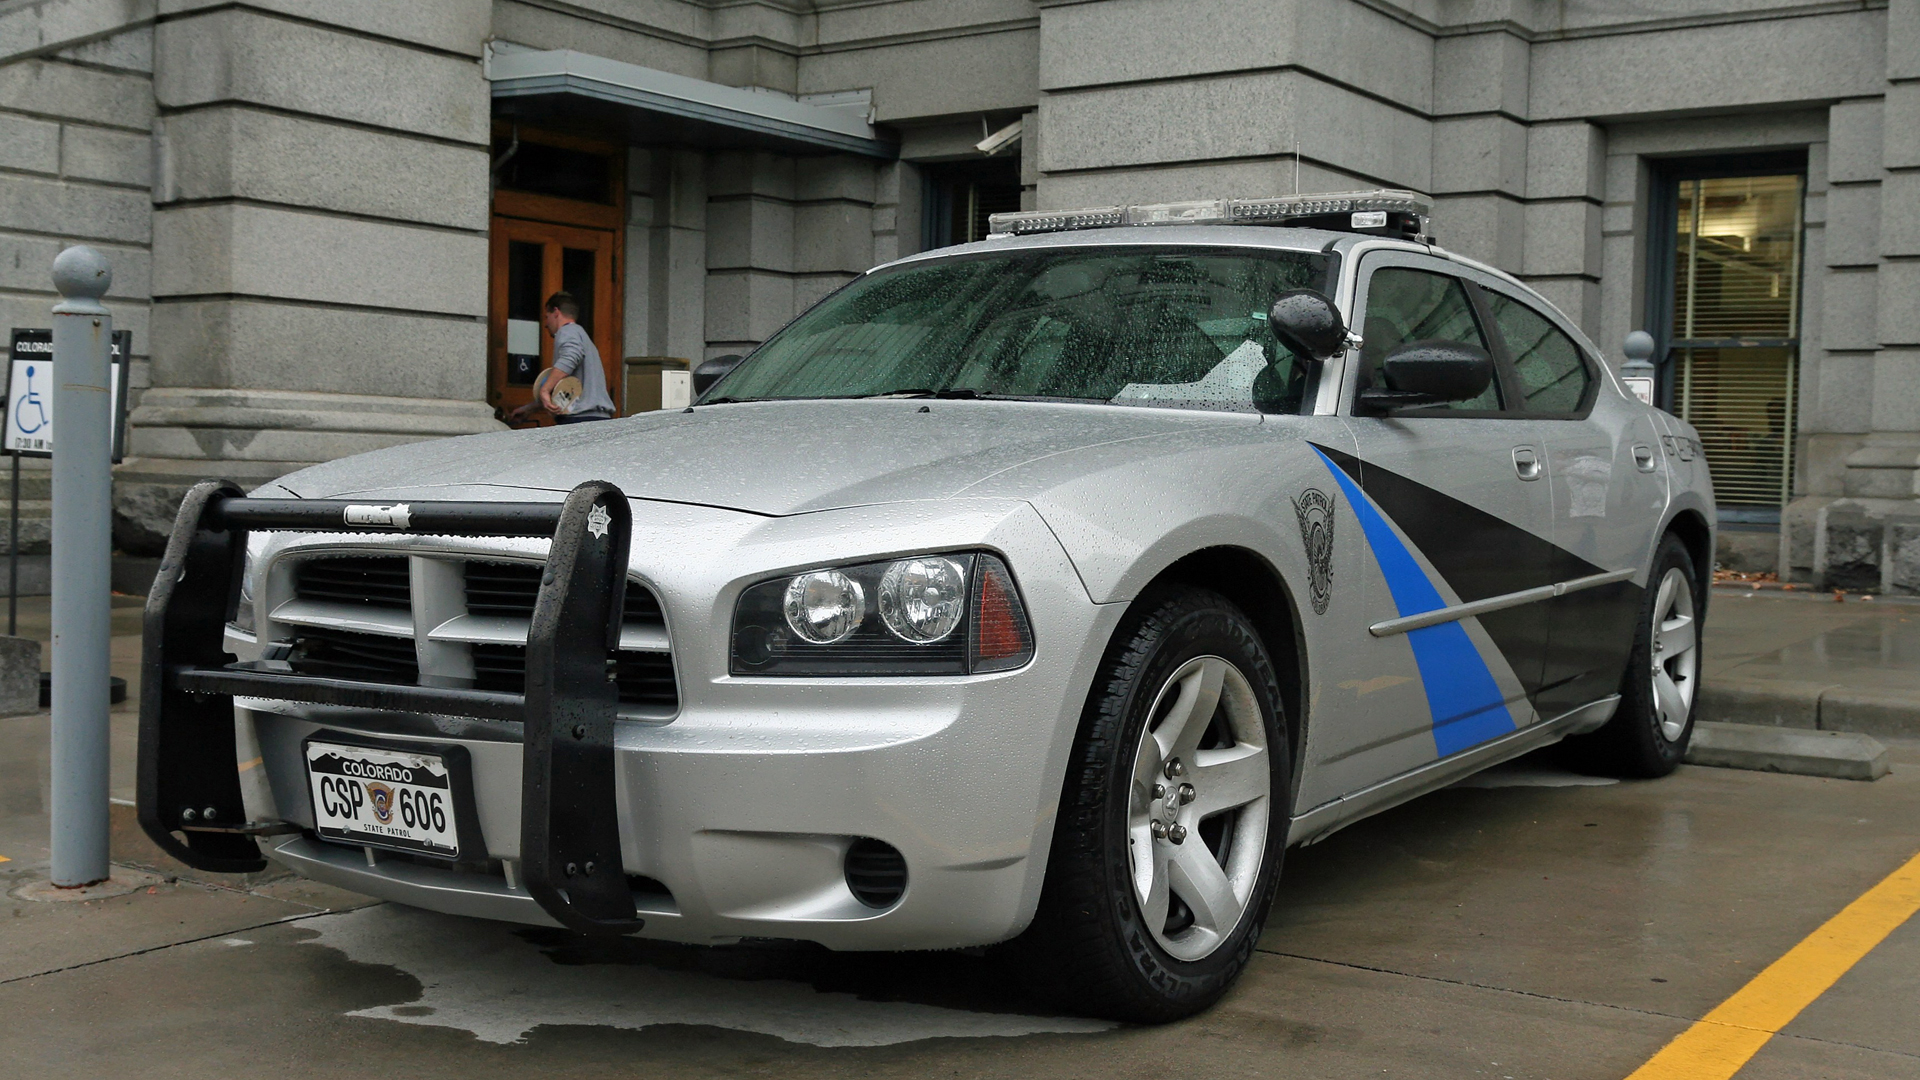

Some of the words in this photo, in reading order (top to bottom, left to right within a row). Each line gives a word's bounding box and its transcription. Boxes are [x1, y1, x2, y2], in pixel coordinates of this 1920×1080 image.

[16, 341, 54, 352] COLORAD
[1300, 493, 1312, 513] STATE
[342, 761, 413, 783] COLORADO
[320, 775, 364, 821] CSP
[399, 787, 446, 834] 606
[363, 823, 384, 834] STATE
[387, 827, 412, 838] PATROL
